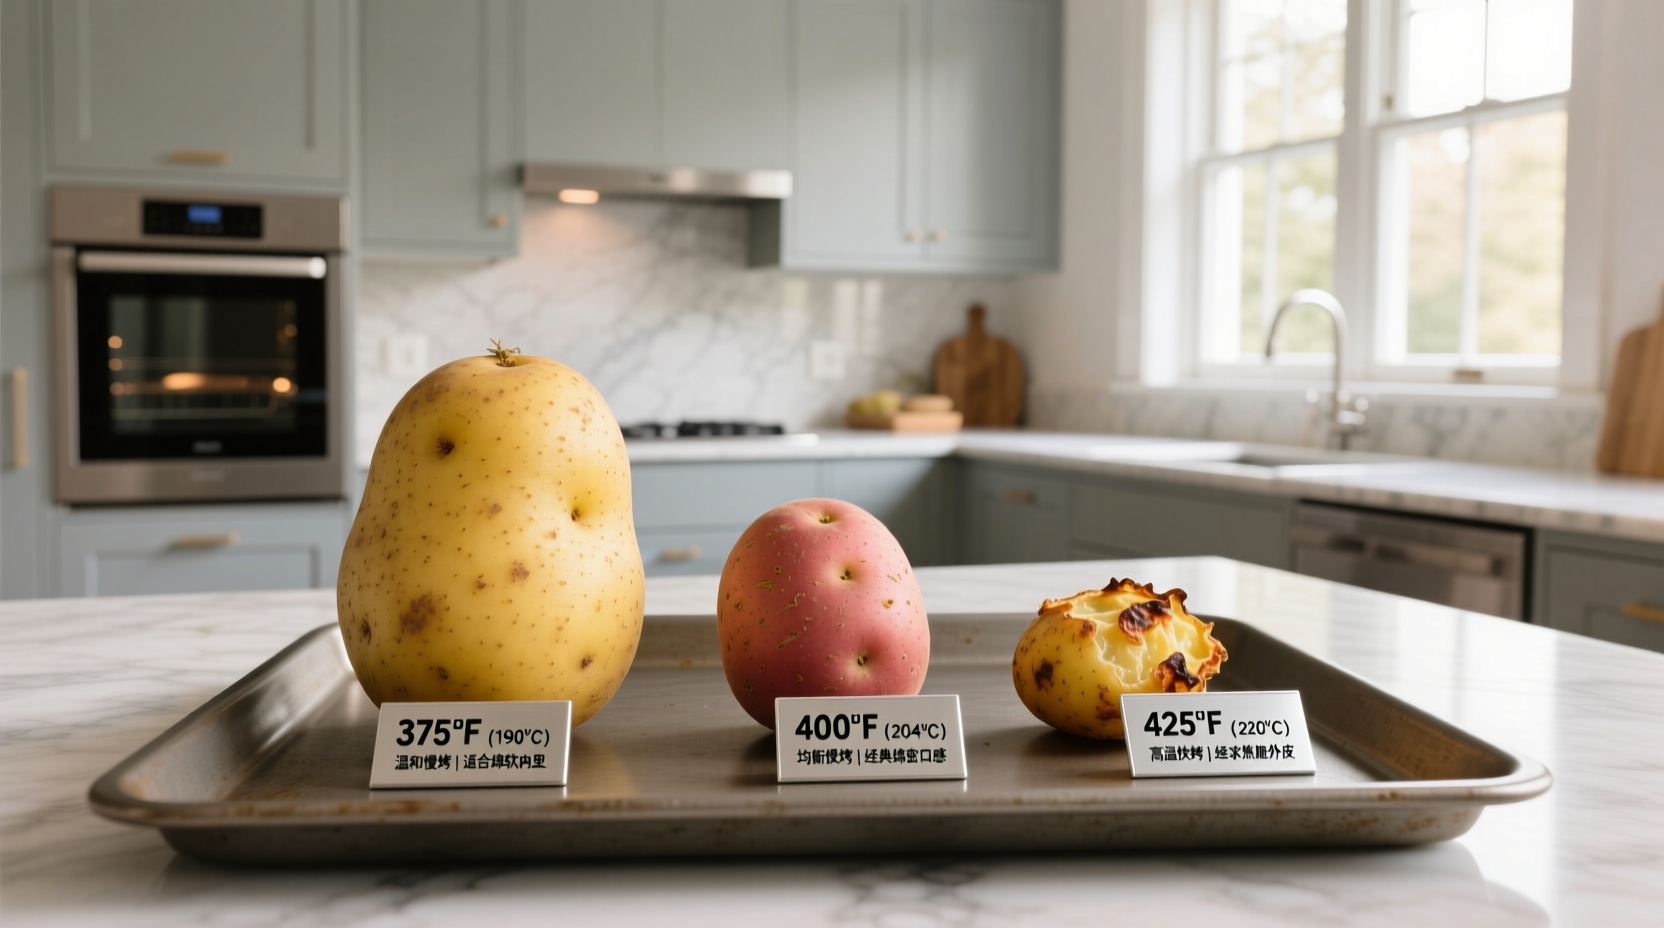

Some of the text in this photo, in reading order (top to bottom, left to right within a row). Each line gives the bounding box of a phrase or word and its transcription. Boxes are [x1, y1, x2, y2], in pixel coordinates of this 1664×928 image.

[395, 718, 483, 747] 375°F
[794, 713, 879, 741] 400°F
[1143, 710, 1222, 737] 425°F
